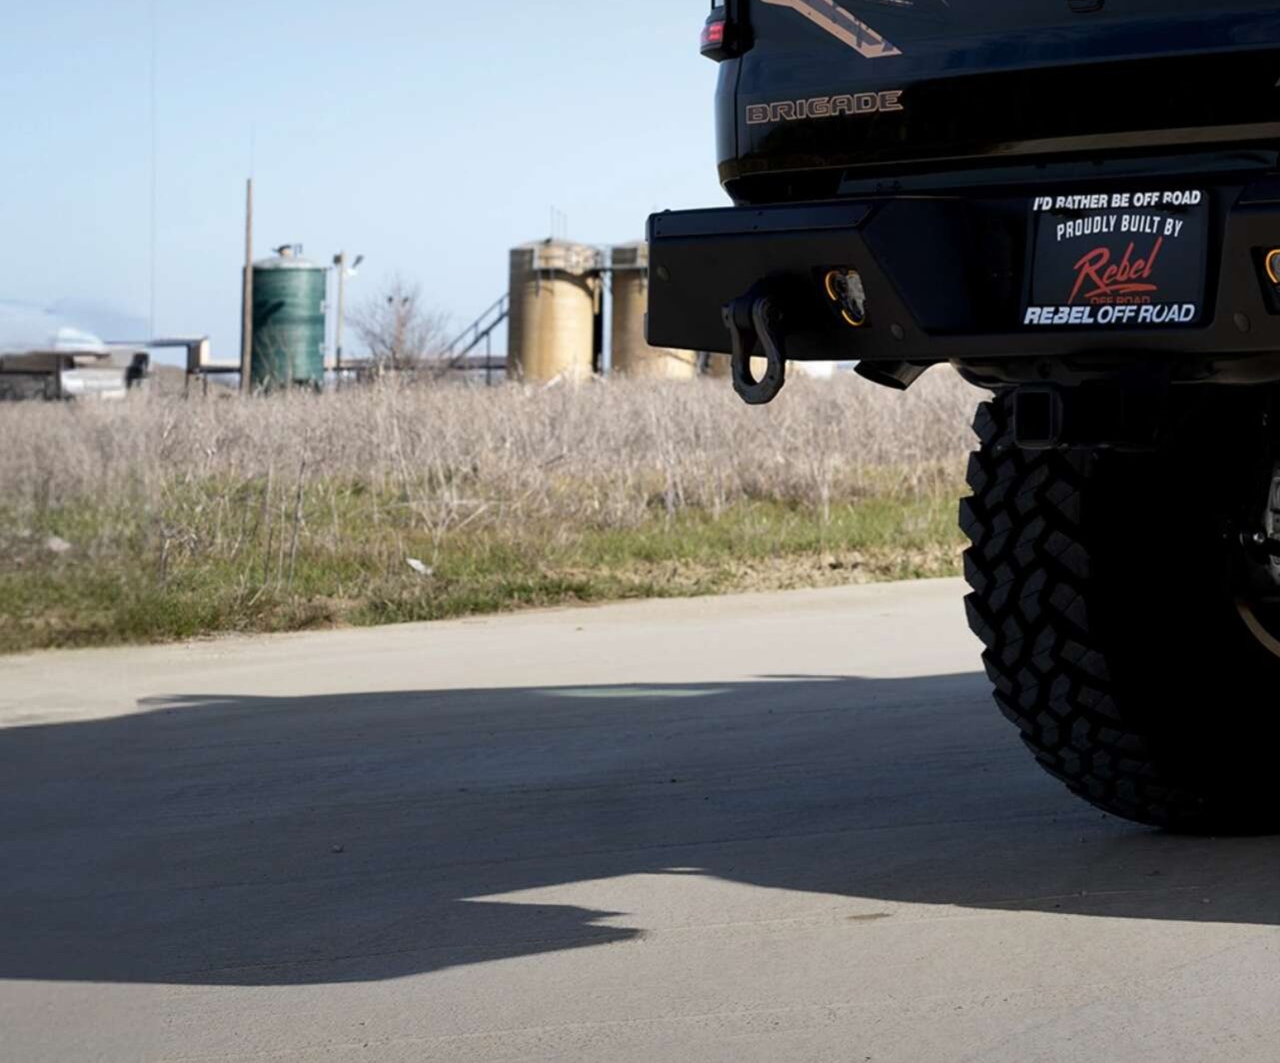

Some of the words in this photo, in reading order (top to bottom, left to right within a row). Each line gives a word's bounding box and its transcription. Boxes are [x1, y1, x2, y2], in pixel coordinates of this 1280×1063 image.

[746, 90, 904, 125] BRIGADE
[1033, 196, 1052, 211] I'D
[1056, 194, 1107, 209] RATHER
[1111, 193, 1130, 208] BE
[1133, 192, 1160, 207] OFF
[1162, 190, 1201, 205] ROAD
[1056, 214, 1118, 241] PROUDLY
[1120, 214, 1161, 235] BUILT
[1163, 217, 1183, 237] BY
[1067, 235, 1163, 305] Rebel
[1023, 306, 1094, 325] REBEL
[1097, 305, 1137, 324] OFF
[1137, 304, 1195, 323] ROAD
